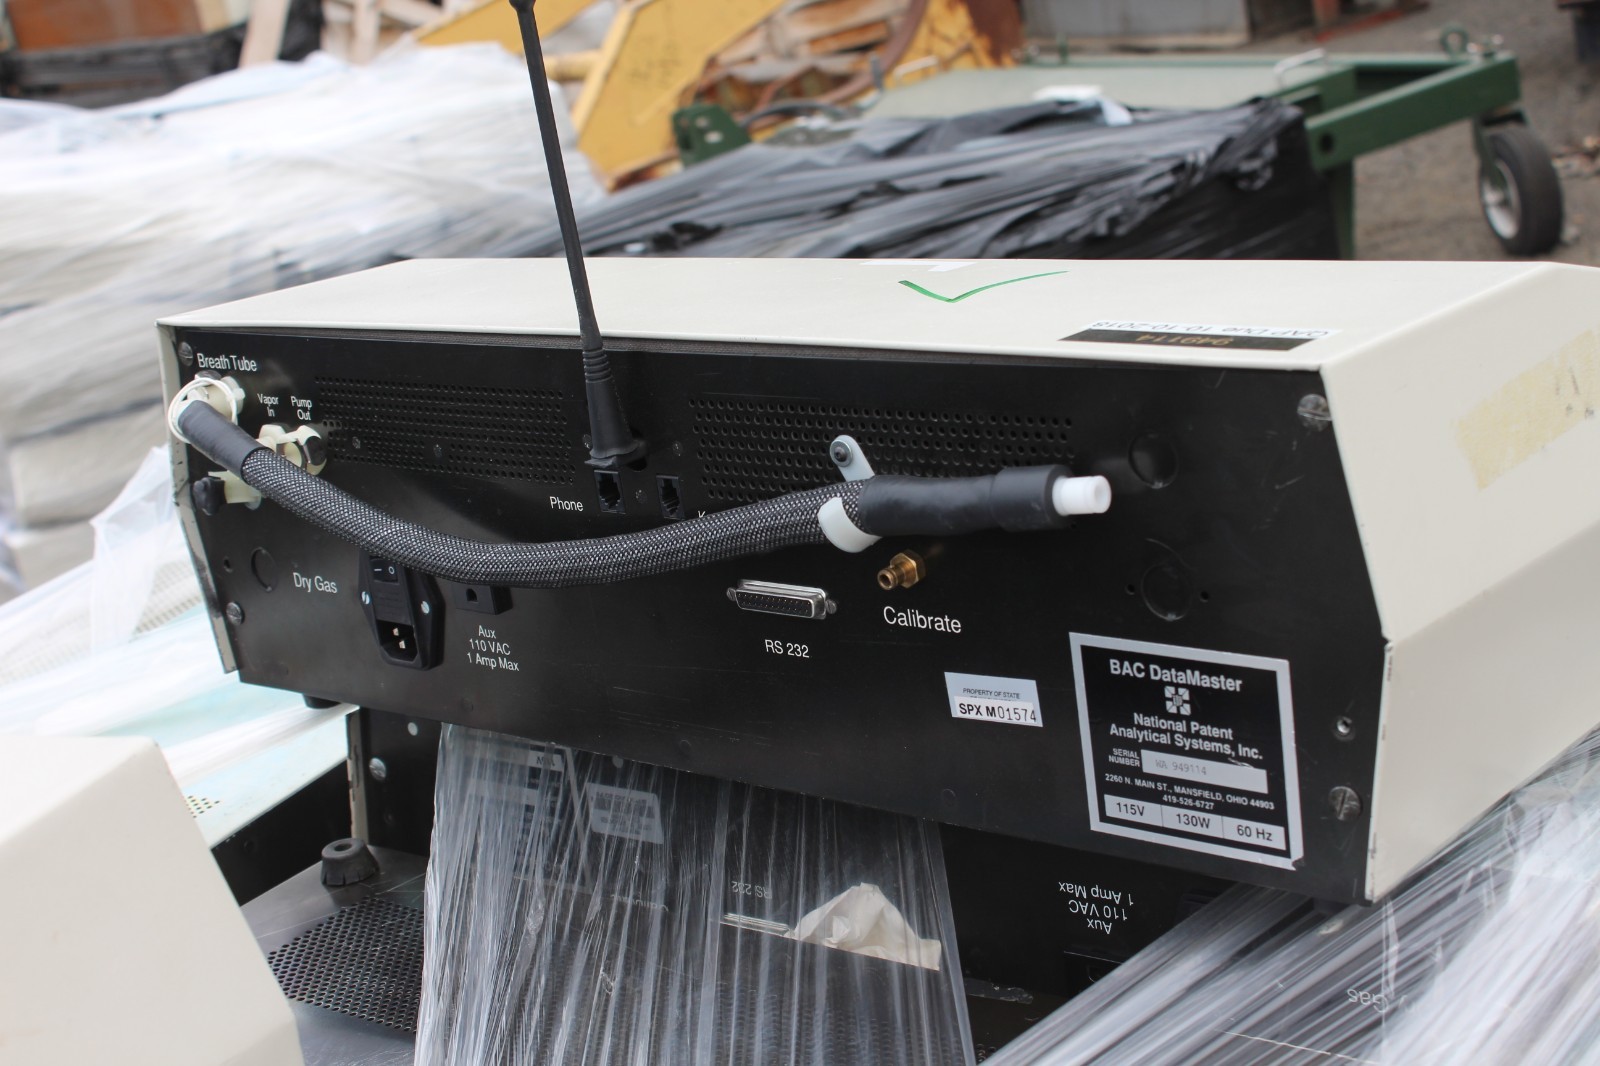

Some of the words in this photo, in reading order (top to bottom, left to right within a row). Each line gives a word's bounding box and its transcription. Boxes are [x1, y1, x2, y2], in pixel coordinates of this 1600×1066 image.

[1222, 327, 1265, 335] Due
[1135, 334, 1233, 346] 949114
[197, 353, 230, 369] Breath
[229, 355, 257, 372] Tube
[257, 393, 279, 406] Vapor
[291, 396, 312, 409] Pump
[267, 406, 275, 417] In
[297, 410, 311, 420] Out
[550, 496, 583, 512] Phone
[293, 572, 312, 593] Dry
[314, 576, 338, 594] Gas
[883, 605, 962, 634] Calibrate
[478, 625, 496, 639] Aux
[469, 638, 486, 652] 110
[489, 641, 511, 656] VAC
[764, 639, 784, 655] RS
[786, 643, 810, 658] 232
[467, 652, 473, 664] 1
[475, 654, 497, 670] Amp
[499, 658, 520, 672] Max
[1109, 659, 1145, 678] BAC
[1149, 664, 1242, 692] DataMaster
[962, 688, 992, 697] PROPERTY
[1003, 691, 1020, 699] STATE
[959, 703, 983, 716] SPX
[1133, 712, 1187, 733] National
[1190, 721, 1233, 740] Patent
[1109, 723, 1171, 744] Analytical
[1175, 735, 1235, 757] Systems,
[1238, 744, 1263, 759] Inc.
[1108, 755, 1140, 767] NUMBER
[1112, 748, 1140, 759] SERIAL
[1155, 759, 1168, 769] WA
[1172, 762, 1207, 775] 949114
[1105, 773, 1123, 783] 2260
[1124, 777, 1133, 785] N.
[1135, 779, 1155, 789] MAIN
[1174, 785, 1224, 802] MANSFIELD,
[1226, 794, 1248, 805] OHIO
[1249, 799, 1275, 810] 44903
[1116, 802, 1145, 817] 115V
[1176, 813, 1211, 829] 130W
[1237, 824, 1252, 837] 60
[1256, 827, 1273, 842] Hz
[1058, 881, 1087, 899] Max
[1090, 884, 1122, 905] Amp
[1128, 893, 1134, 906] 1
[1068, 899, 1100, 918] VAC
[1103, 905, 1128, 921] 110
[1086, 918, 1113, 935] Aux
[1347, 989, 1389, 1013] Gas
